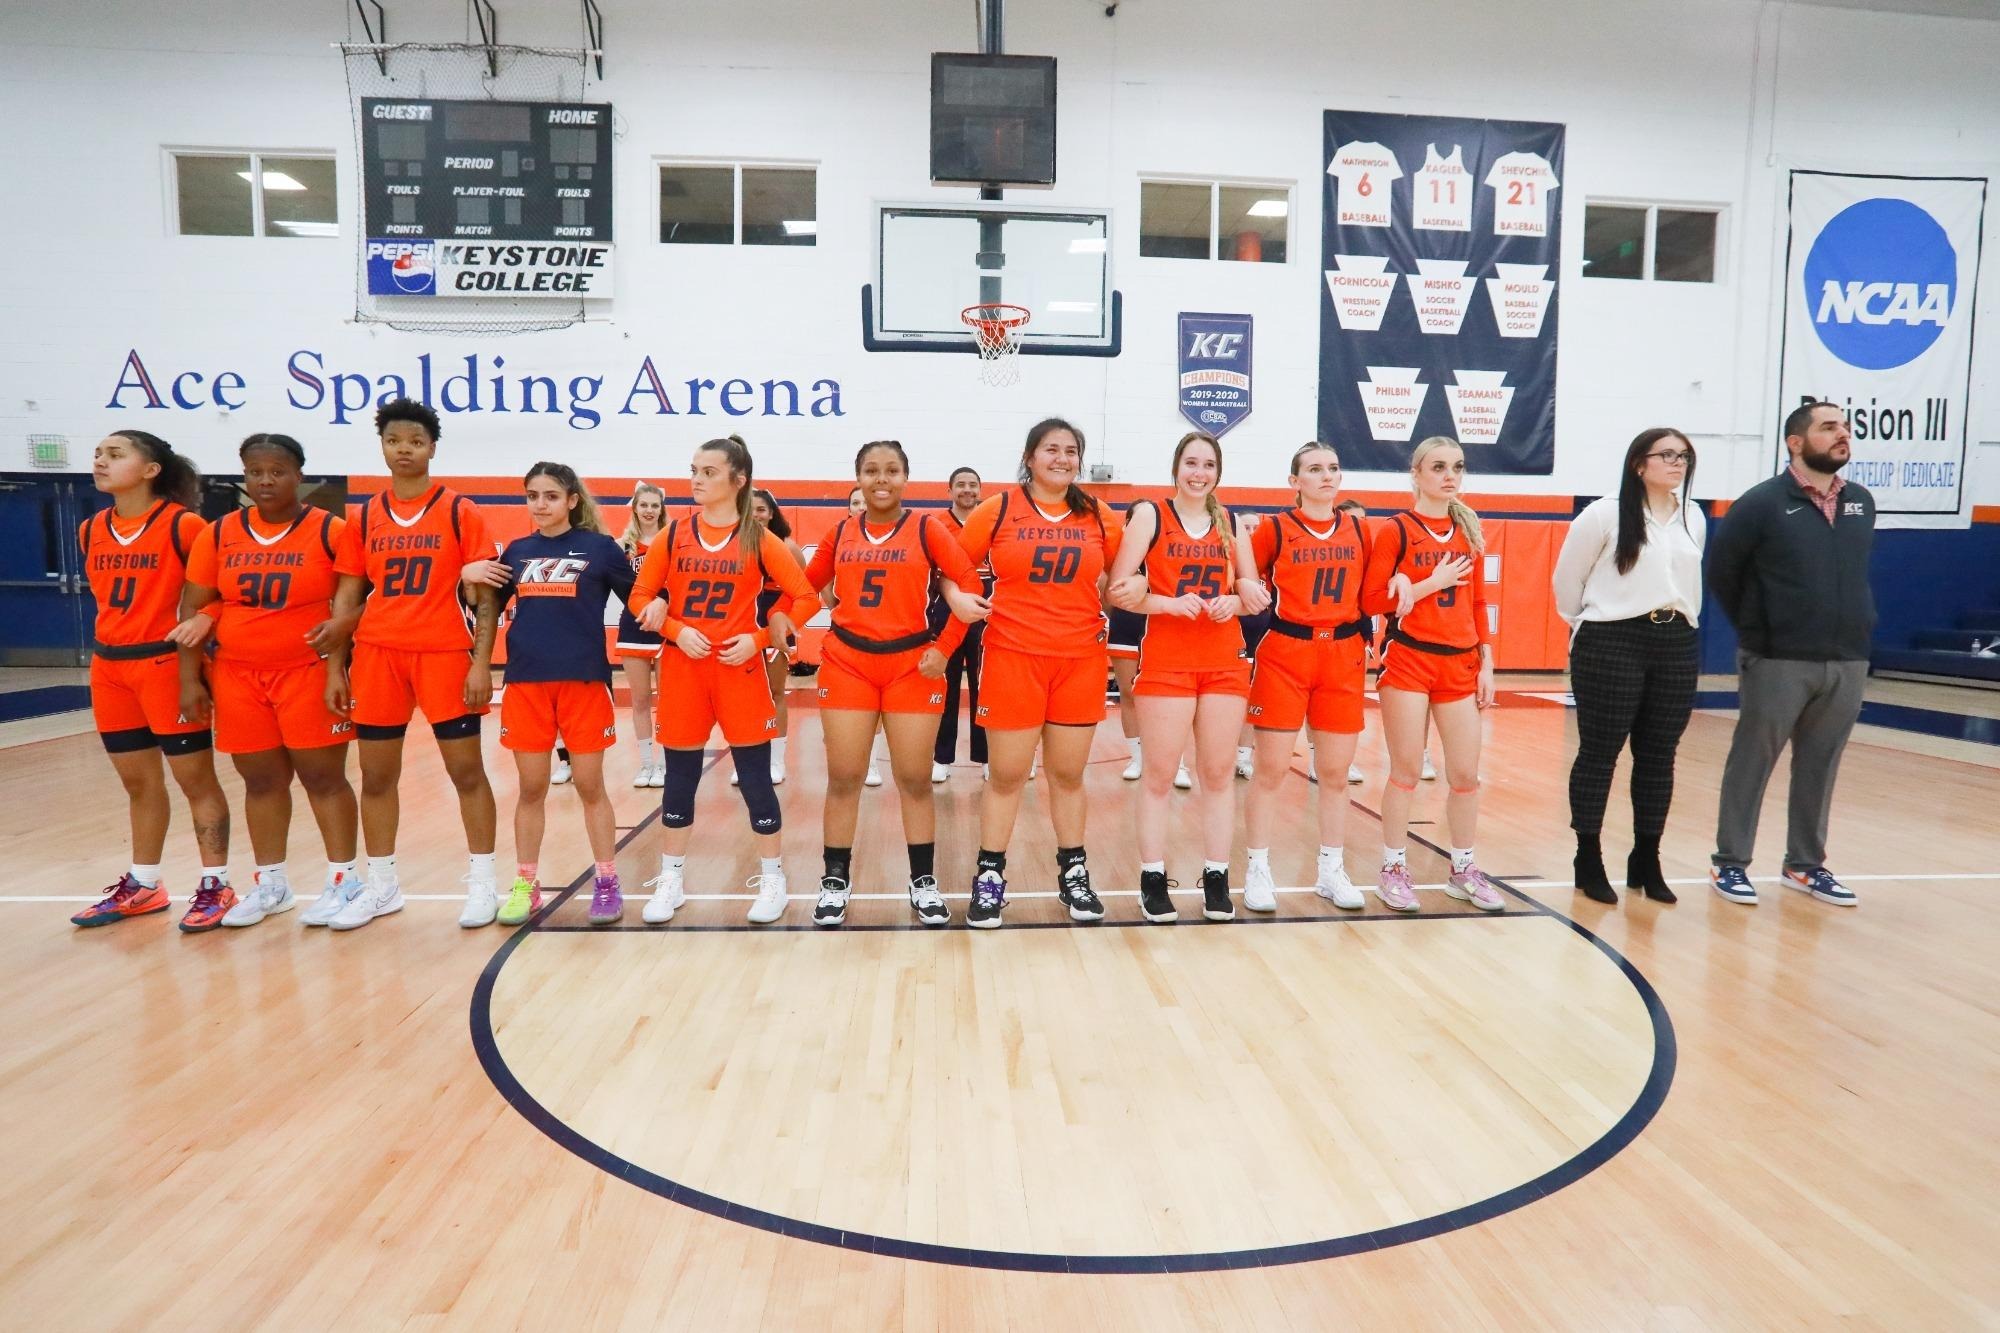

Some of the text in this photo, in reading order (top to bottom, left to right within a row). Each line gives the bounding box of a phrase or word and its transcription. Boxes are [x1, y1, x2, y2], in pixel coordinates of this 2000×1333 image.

[373, 105, 431, 120] GUEST
[548, 110, 598, 124] HOME
[444, 157, 494, 169] PERIOD
[1342, 159, 1389, 168] MATHEWSON
[1426, 164, 1463, 174] KAGLER
[387, 185, 420, 195] FOULS
[1358, 172, 1372, 197] 6
[453, 186, 525, 197] PLAYER-FOUL
[557, 188, 590, 198] FOULS
[1430, 179, 1456, 204] 11
[1507, 180, 1535, 205] 21
[1342, 212, 1388, 223] BASEBALL
[1422, 218, 1463, 227] BASKETBALL
[386, 225, 423, 234] POINTS
[455, 225, 492, 235] MATCH
[555, 227, 592, 236] POINTS
[1500, 221, 1544, 232] BASEBALL
[367, 243, 435, 260] PEPSI
[441, 246, 608, 267] KEYSTONE
[455, 271, 594, 292] COLLEGE
[1333, 277, 1390, 288] FORNICOLA
[1424, 280, 1462, 290] MISHKO
[1504, 283, 1539, 294] MOULD
[1342, 297, 1381, 307] WRESTLING
[1426, 296, 1456, 305] SOCCER
[1504, 300, 1539, 309] BASEBALL
[1816, 279, 1950, 327] NCAA
[1347, 308, 1376, 318] COACH
[1420, 307, 1461, 317] BASKETBALL
[1506, 311, 1537, 319] SOCCER
[1426, 318, 1455, 327] COACH
[1506, 321, 1536, 330] COACH
[1188, 332, 1244, 358] KC
[1184, 371, 1245, 387] CHAMPIONS
[105, 348, 847, 430] Ace Spalding Arena
[1375, 386, 1411, 397] PHILBIN
[1457, 389, 1503, 400] SEAMANS
[1190, 390, 1239, 400] 2019-2020
[1368, 406, 1417, 416] FIELD HOCKEY
[1463, 406, 1497, 415] BASEBALL
[1459, 416, 1500, 425] BASKETBALL
[1925, 398, 1948, 441] III
[1378, 421, 1406, 430] COACH
[1461, 427, 1497, 436] FOOTBALL
[1903, 462, 1954, 487] DEDICATE
[1017, 528, 1086, 542] KEYSTONE
[371, 534, 441, 554] KEYSTONE
[839, 549, 907, 564] KEYSTONE
[1293, 546, 1355, 564] KEYSTONE
[93, 553, 159, 571] KEYSTONE
[225, 553, 304, 569] KEYSTONE
[1028, 546, 1082, 584] 50
[519, 558, 589, 583] KC
[383, 556, 432, 597] 20
[1175, 565, 1224, 600] 25
[1312, 567, 1347, 605] 14
[237, 572, 292, 610] 30
[859, 569, 887, 608] 5
[109, 576, 137, 615] 4
[682, 580, 735, 619] 22
